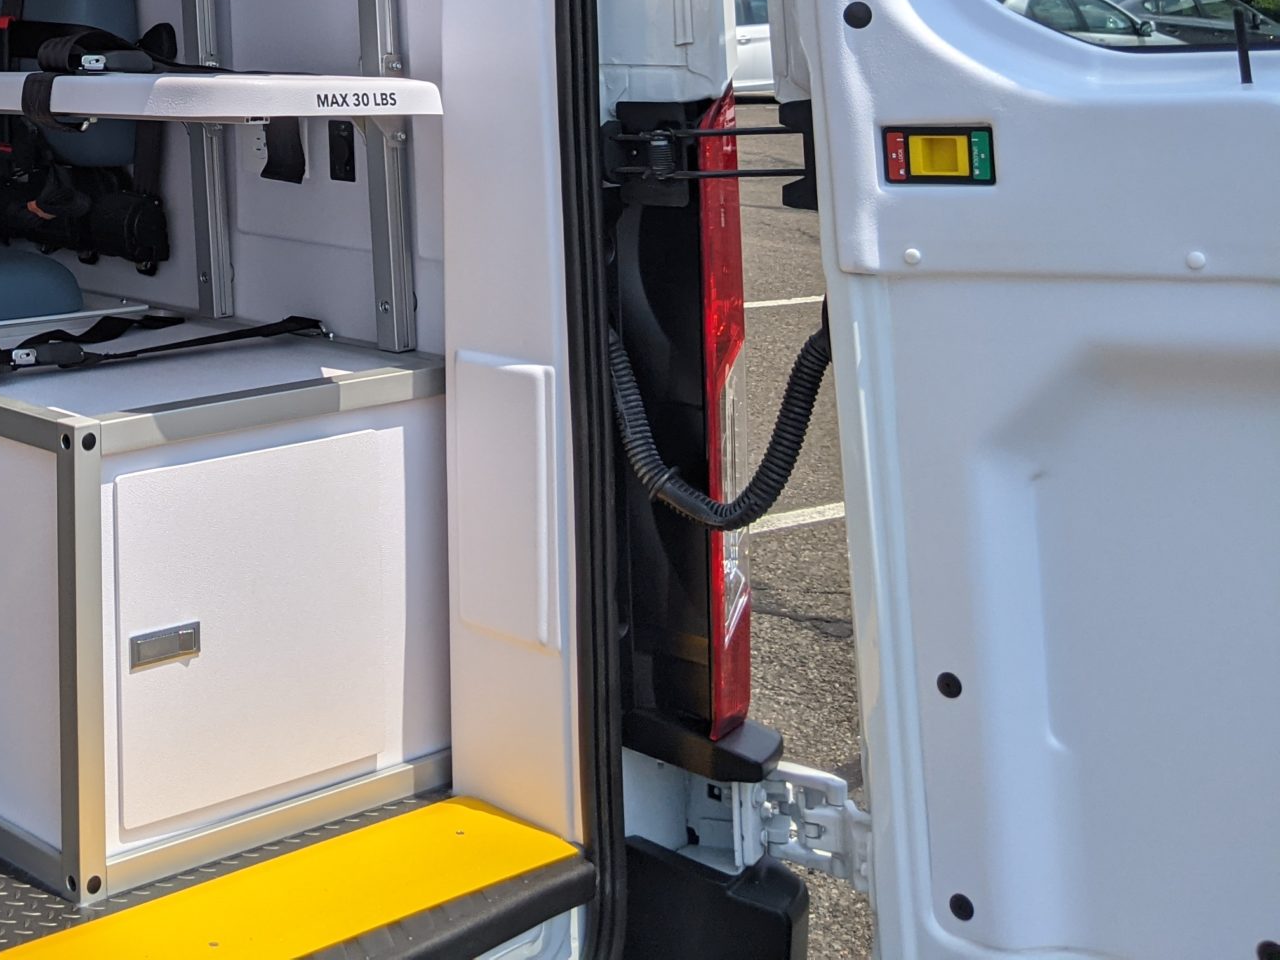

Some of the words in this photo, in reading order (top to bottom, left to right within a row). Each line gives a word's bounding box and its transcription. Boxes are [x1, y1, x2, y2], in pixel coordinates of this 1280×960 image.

[316, 93, 350, 108] MAX
[352, 92, 370, 107] 30
[373, 92, 397, 107] LBS
